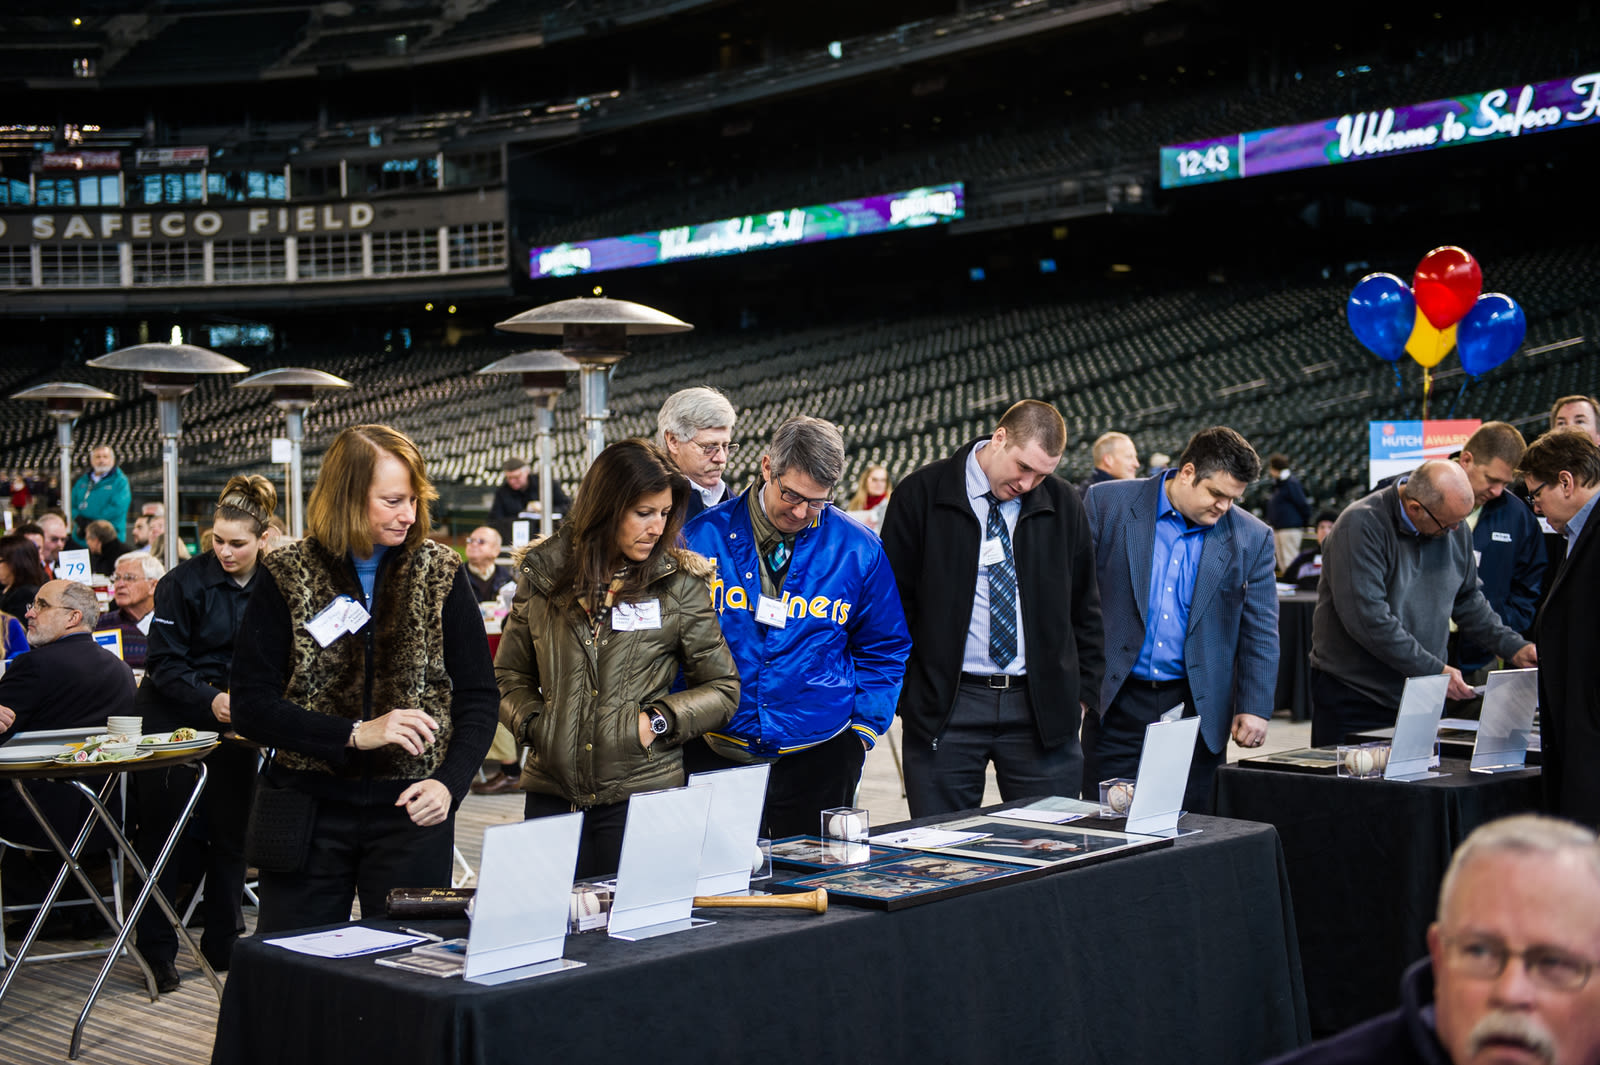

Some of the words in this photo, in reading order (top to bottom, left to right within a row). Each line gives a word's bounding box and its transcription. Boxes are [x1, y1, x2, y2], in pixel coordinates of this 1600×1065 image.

[1336, 108, 1438, 158] Welcome
[1442, 111, 1466, 142] to
[1468, 84, 1561, 137] Safeco
[1566, 72, 1600, 122] F
[1177, 145, 1230, 177] 12:43
[32, 210, 222, 239] SAFECO
[249, 202, 374, 234] FIELD
[1382, 434, 1423, 448] HUTCH
[65, 562, 85, 577] 79
[708, 557, 852, 625] aners
